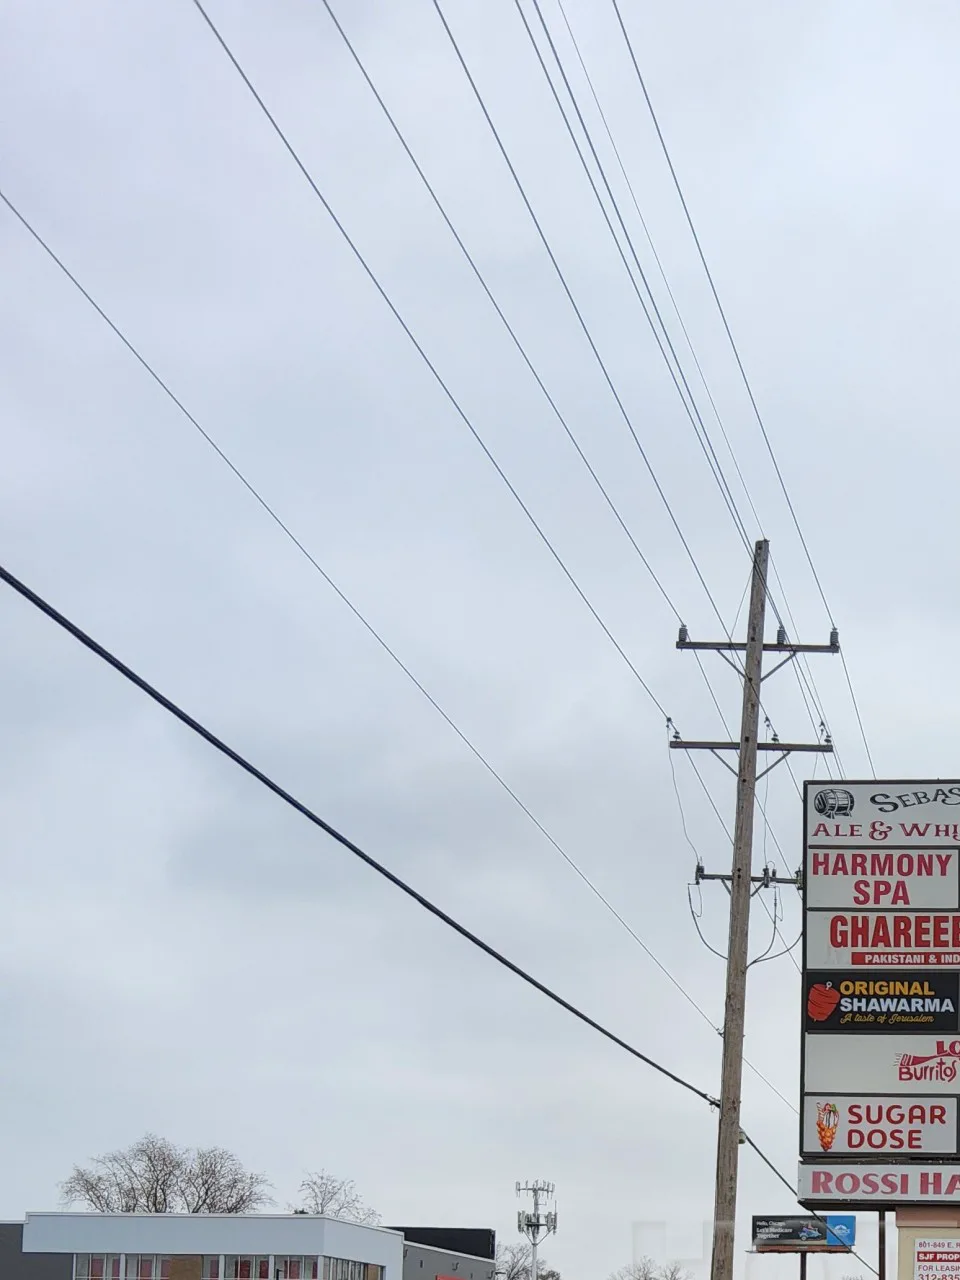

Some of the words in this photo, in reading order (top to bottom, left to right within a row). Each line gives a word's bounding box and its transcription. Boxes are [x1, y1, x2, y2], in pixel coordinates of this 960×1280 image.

[812, 823, 862, 838] ALE
[868, 820, 893, 841] &
[812, 853, 952, 877] HARMONY
[853, 880, 911, 906] SPA
[864, 954, 926, 964] PAKISTANI
[928, 954, 937, 964] &
[840, 980, 935, 996] ORIGINAL
[840, 997, 955, 1013] SHAWARMA
[840, 1013, 853, 1024] A
[854, 1014, 875, 1023] taste
[876, 1014, 887, 1023] of
[888, 1014, 934, 1024] Jerusalem
[898, 1058, 957, 1082] Burritos
[847, 1103, 947, 1125] SUGAR
[847, 1128, 922, 1149] DOSE
[811, 1170, 909, 1196] ROSSI
[918, 1253, 935, 1261] SJF
[918, 1264, 934, 1272] FOR
